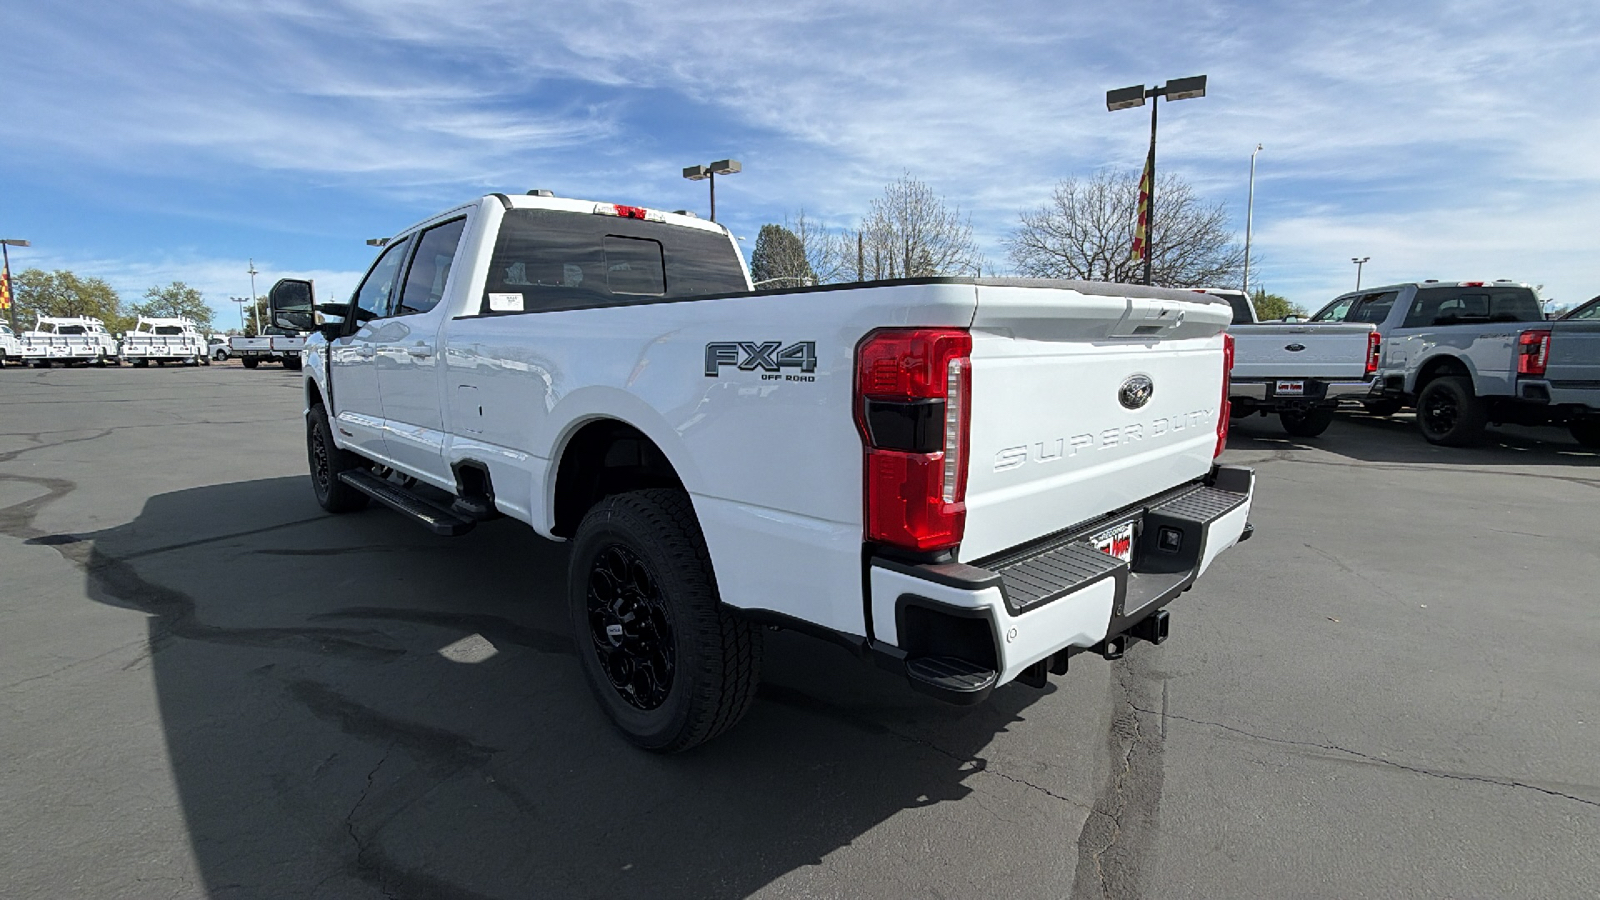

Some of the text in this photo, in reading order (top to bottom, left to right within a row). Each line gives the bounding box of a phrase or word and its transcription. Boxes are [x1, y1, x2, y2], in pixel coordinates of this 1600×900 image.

[704, 341, 818, 377] FX4
[993, 407, 1214, 473] SUPER DUTY
